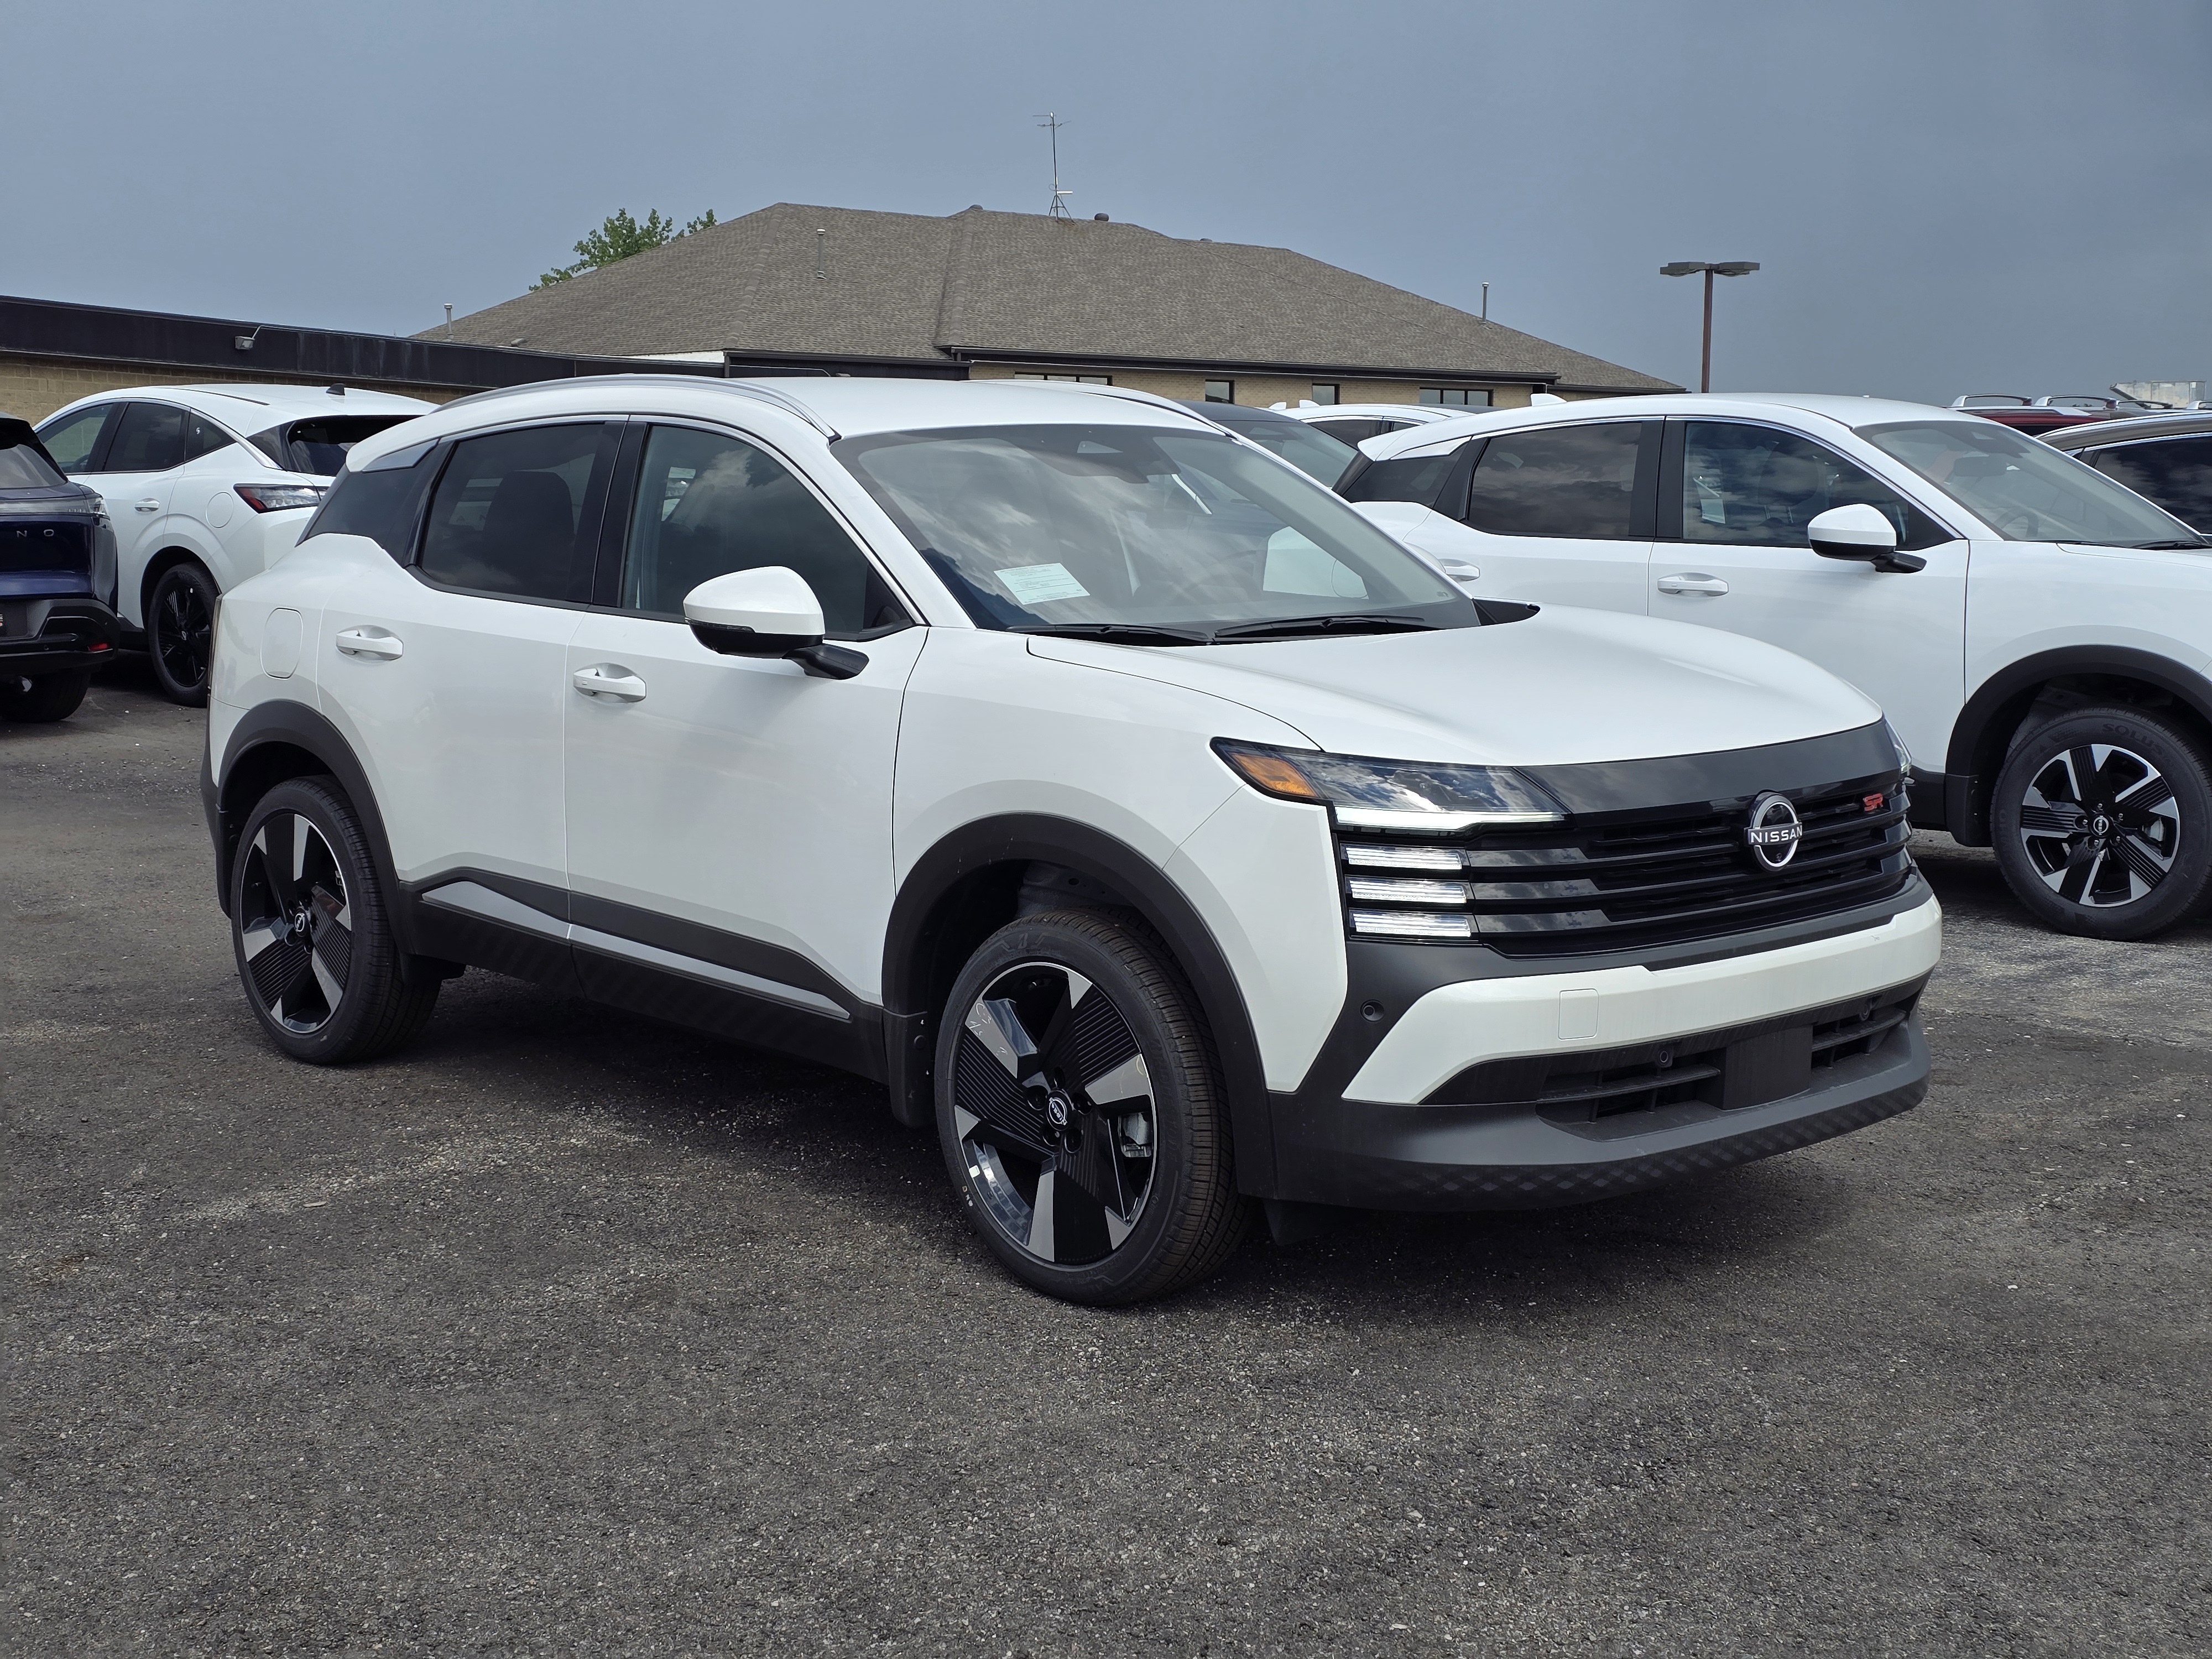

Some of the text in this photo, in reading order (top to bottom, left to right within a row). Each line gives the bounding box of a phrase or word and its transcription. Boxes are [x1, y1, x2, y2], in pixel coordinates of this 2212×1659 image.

[2102, 723, 2164, 756] SOLUS
[1863, 793, 1884, 811] SR
[1751, 825, 1803, 843] NISSAN
